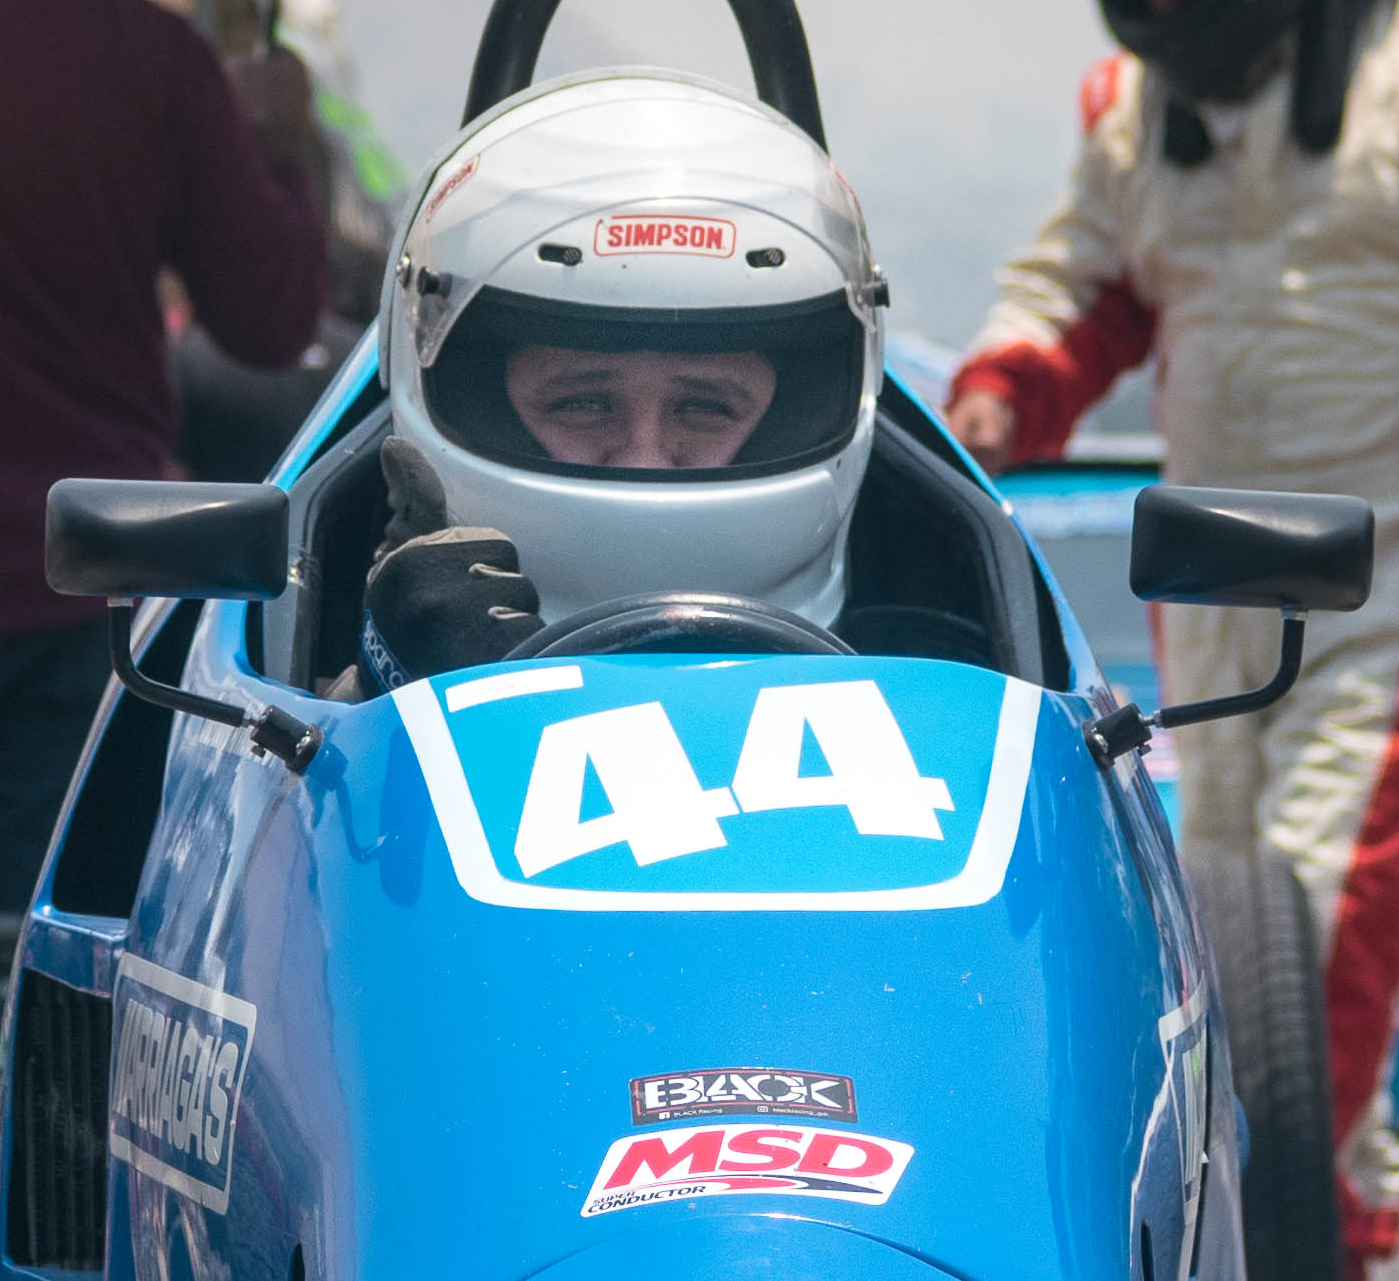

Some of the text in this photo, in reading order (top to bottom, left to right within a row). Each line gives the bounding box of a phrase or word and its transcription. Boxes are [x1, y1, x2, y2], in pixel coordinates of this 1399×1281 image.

[607, 223, 723, 250] SIMPSON
[513, 679, 956, 879] 44
[112, 997, 239, 1166] ARRIAGA'S
[644, 1073, 843, 1110] BLACK
[602, 1128, 894, 1191] MSD
[587, 1185, 707, 1214] CONDUCTOR
